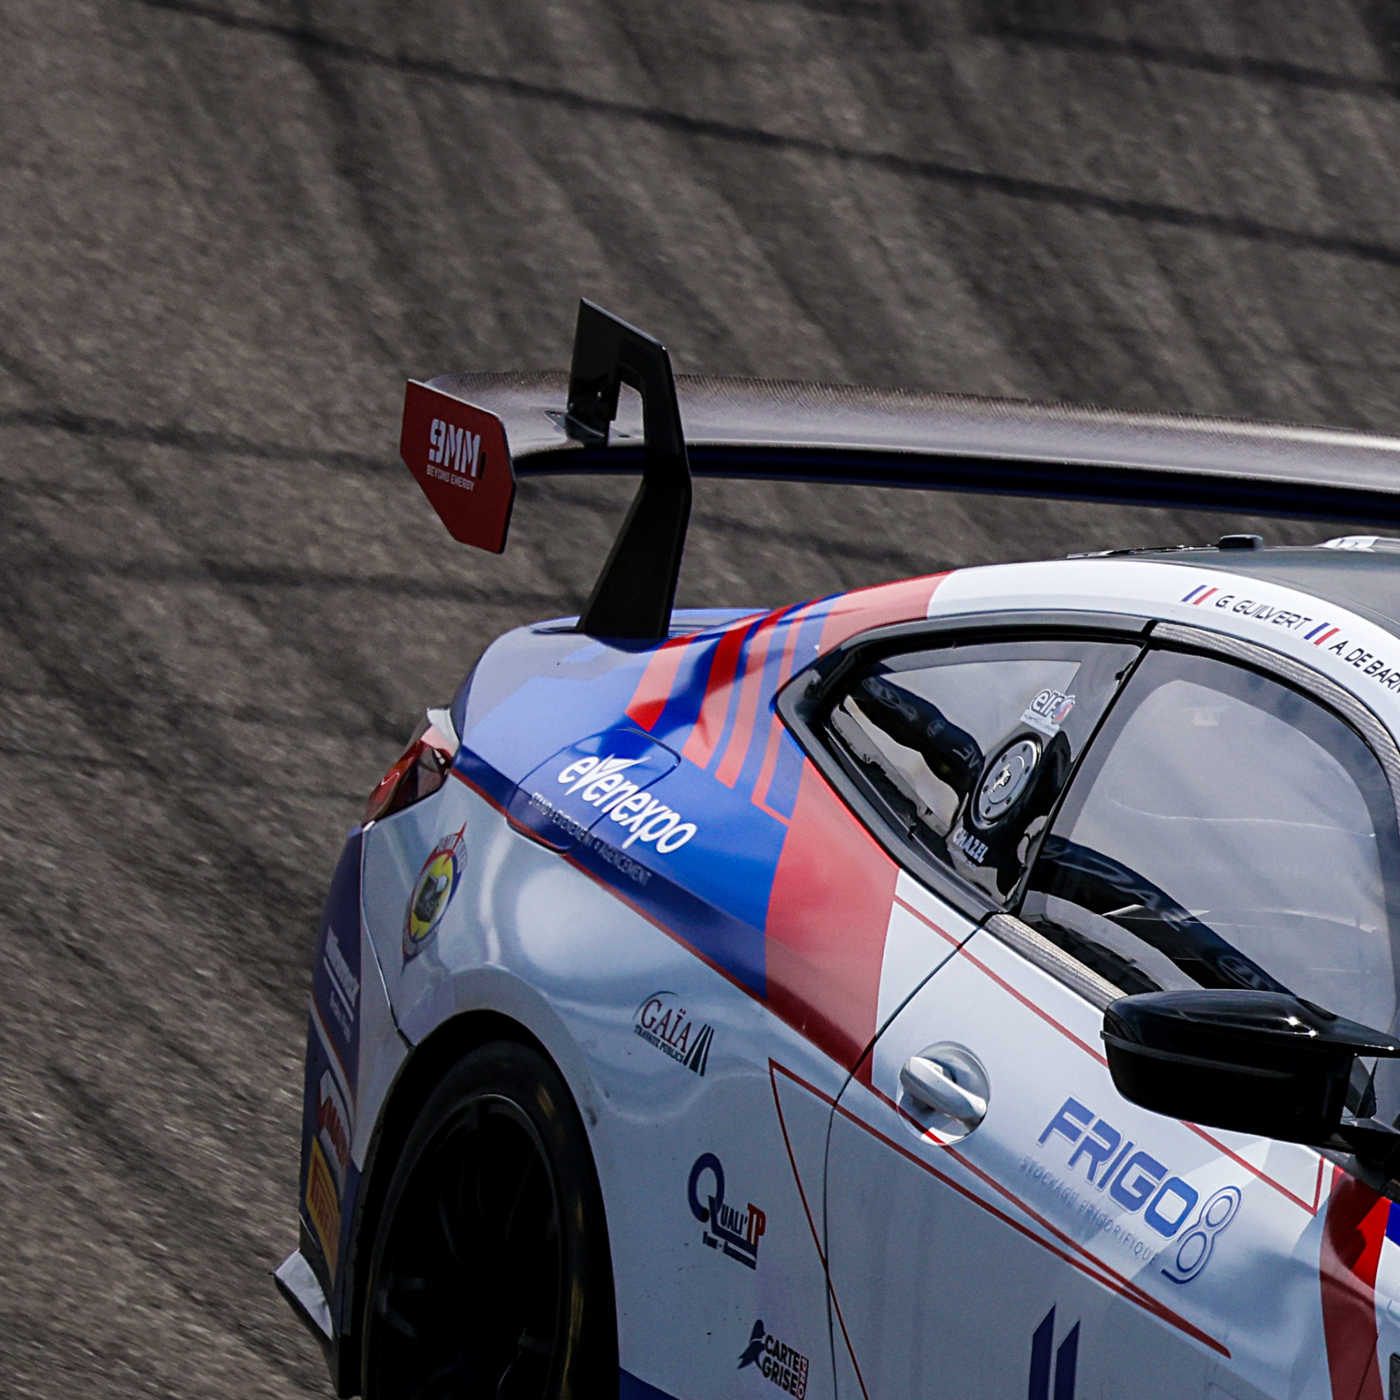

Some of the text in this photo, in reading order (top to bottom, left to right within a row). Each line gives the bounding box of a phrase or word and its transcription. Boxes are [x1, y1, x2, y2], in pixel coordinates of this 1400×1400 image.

[428, 418, 481, 478] 9MM
[1232, 599, 1312, 631] GUILVERT
[1344, 648, 1368, 668] DE
[557, 753, 698, 854] evenexpo
[641, 999, 691, 1054] GAÏA
[765, 1335, 800, 1373] CARTE
[762, 1356, 798, 1397] GRISE
